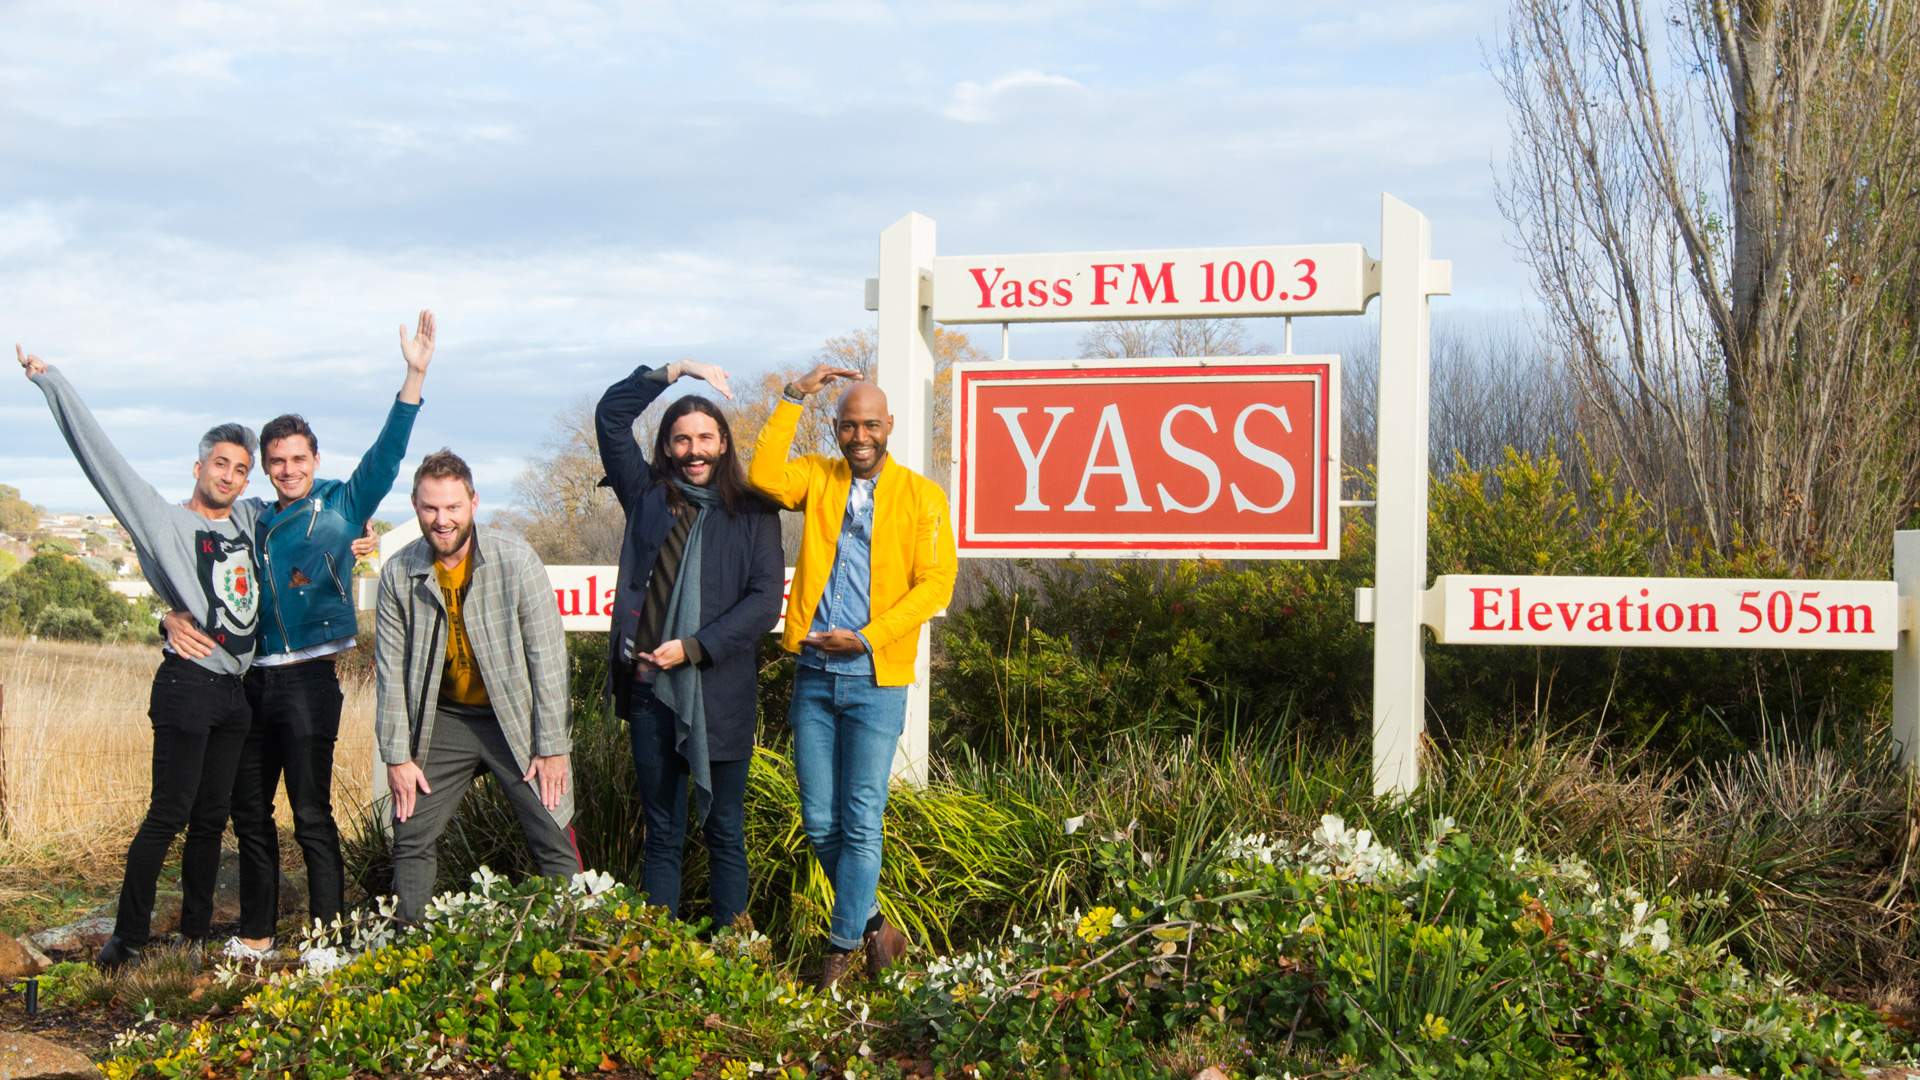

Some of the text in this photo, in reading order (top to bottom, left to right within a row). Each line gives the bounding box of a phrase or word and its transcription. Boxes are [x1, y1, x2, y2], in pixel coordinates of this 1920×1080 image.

[968, 258, 1318, 308] Yass FM 100.3
[993, 403, 1296, 514] YASS
[1469, 588, 1875, 635] Elevation 505m
